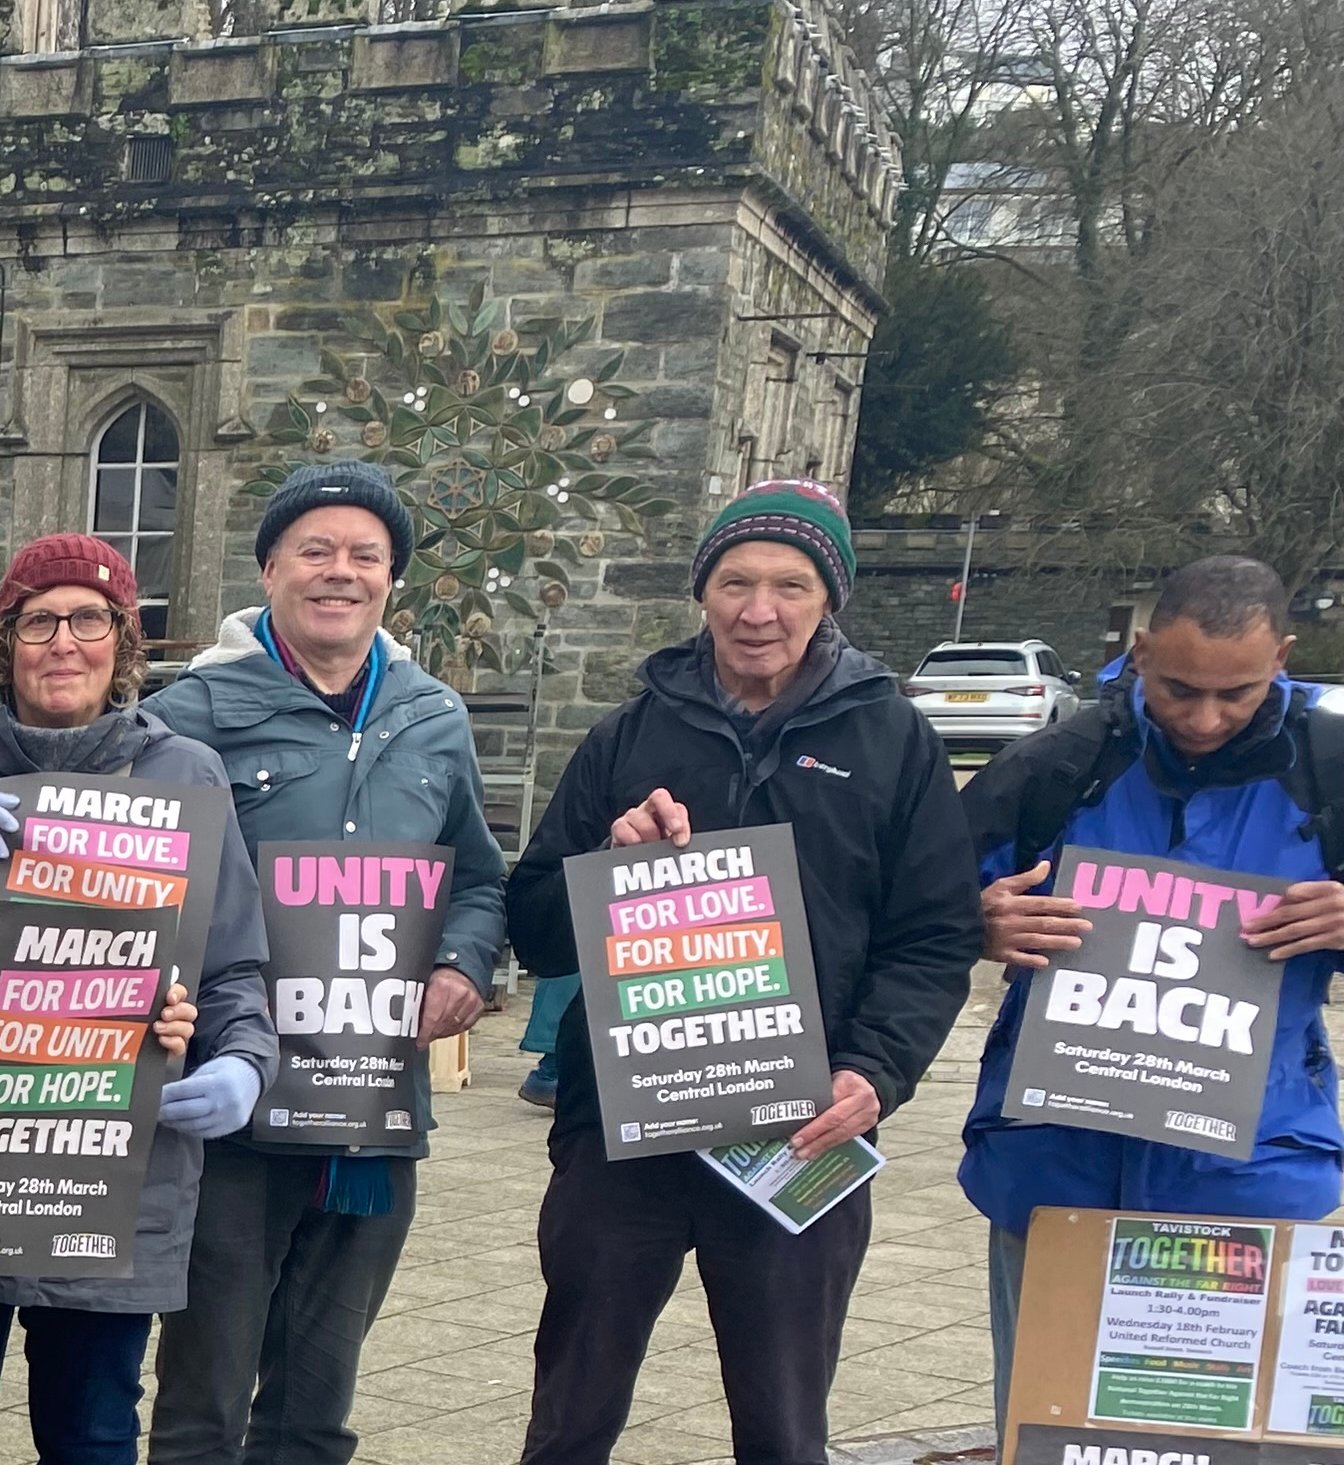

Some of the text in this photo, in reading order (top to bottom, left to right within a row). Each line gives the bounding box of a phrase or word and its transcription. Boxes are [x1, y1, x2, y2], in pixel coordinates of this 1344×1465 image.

[36, 785, 182, 830] MARCH
[16, 857, 75, 893] FOR
[274, 856, 446, 910] UNITY
[613, 846, 755, 896] MARCH
[618, 886, 765, 934] FOR LOVE.
[14, 925, 158, 967] MARCH
[338, 913, 396, 971] IS
[615, 929, 777, 968] FOR UNITY.
[1128, 921, 1203, 981] IS
[2, 977, 145, 1012] FOR LOVE.
[626, 965, 781, 1013] FOR HOPE.
[609, 1003, 804, 1057] TOGETHER
[1045, 969, 1260, 1055] BACK
[47, 1025, 136, 1061] UNITY.
[291, 1055, 388, 1072] Saturday 28th
[312, 1073, 365, 1087] Central
[632, 1055, 795, 1089] Saturday 28th March
[1054, 1041, 1231, 1083] Saturday 28th March
[1075, 1061, 1203, 1093] Central London
[38, 1070, 122, 1105] HOPE.
[656, 1078, 775, 1103] Central London
[18, 1177, 55, 1195] 28th
[57, 1179, 108, 1196] March
[25, 1199, 83, 1217] London
[1152, 1223, 1231, 1237] TAVISTOCK
[1114, 1236, 1264, 1280] TOGETHER
[1111, 1287, 1151, 1297] Launch
[1155, 1291, 1182, 1301] Rally
[1200, 1294, 1261, 1305] Fundraiser
[1112, 1275, 1261, 1294] AGAINST THE FAR RIGHT
[1107, 1317, 1258, 1338] Wednesday 18th February
[1109, 1330, 1148, 1342] United
[1151, 1334, 1208, 1346] Reformed
[1211, 1337, 1251, 1350] Church
